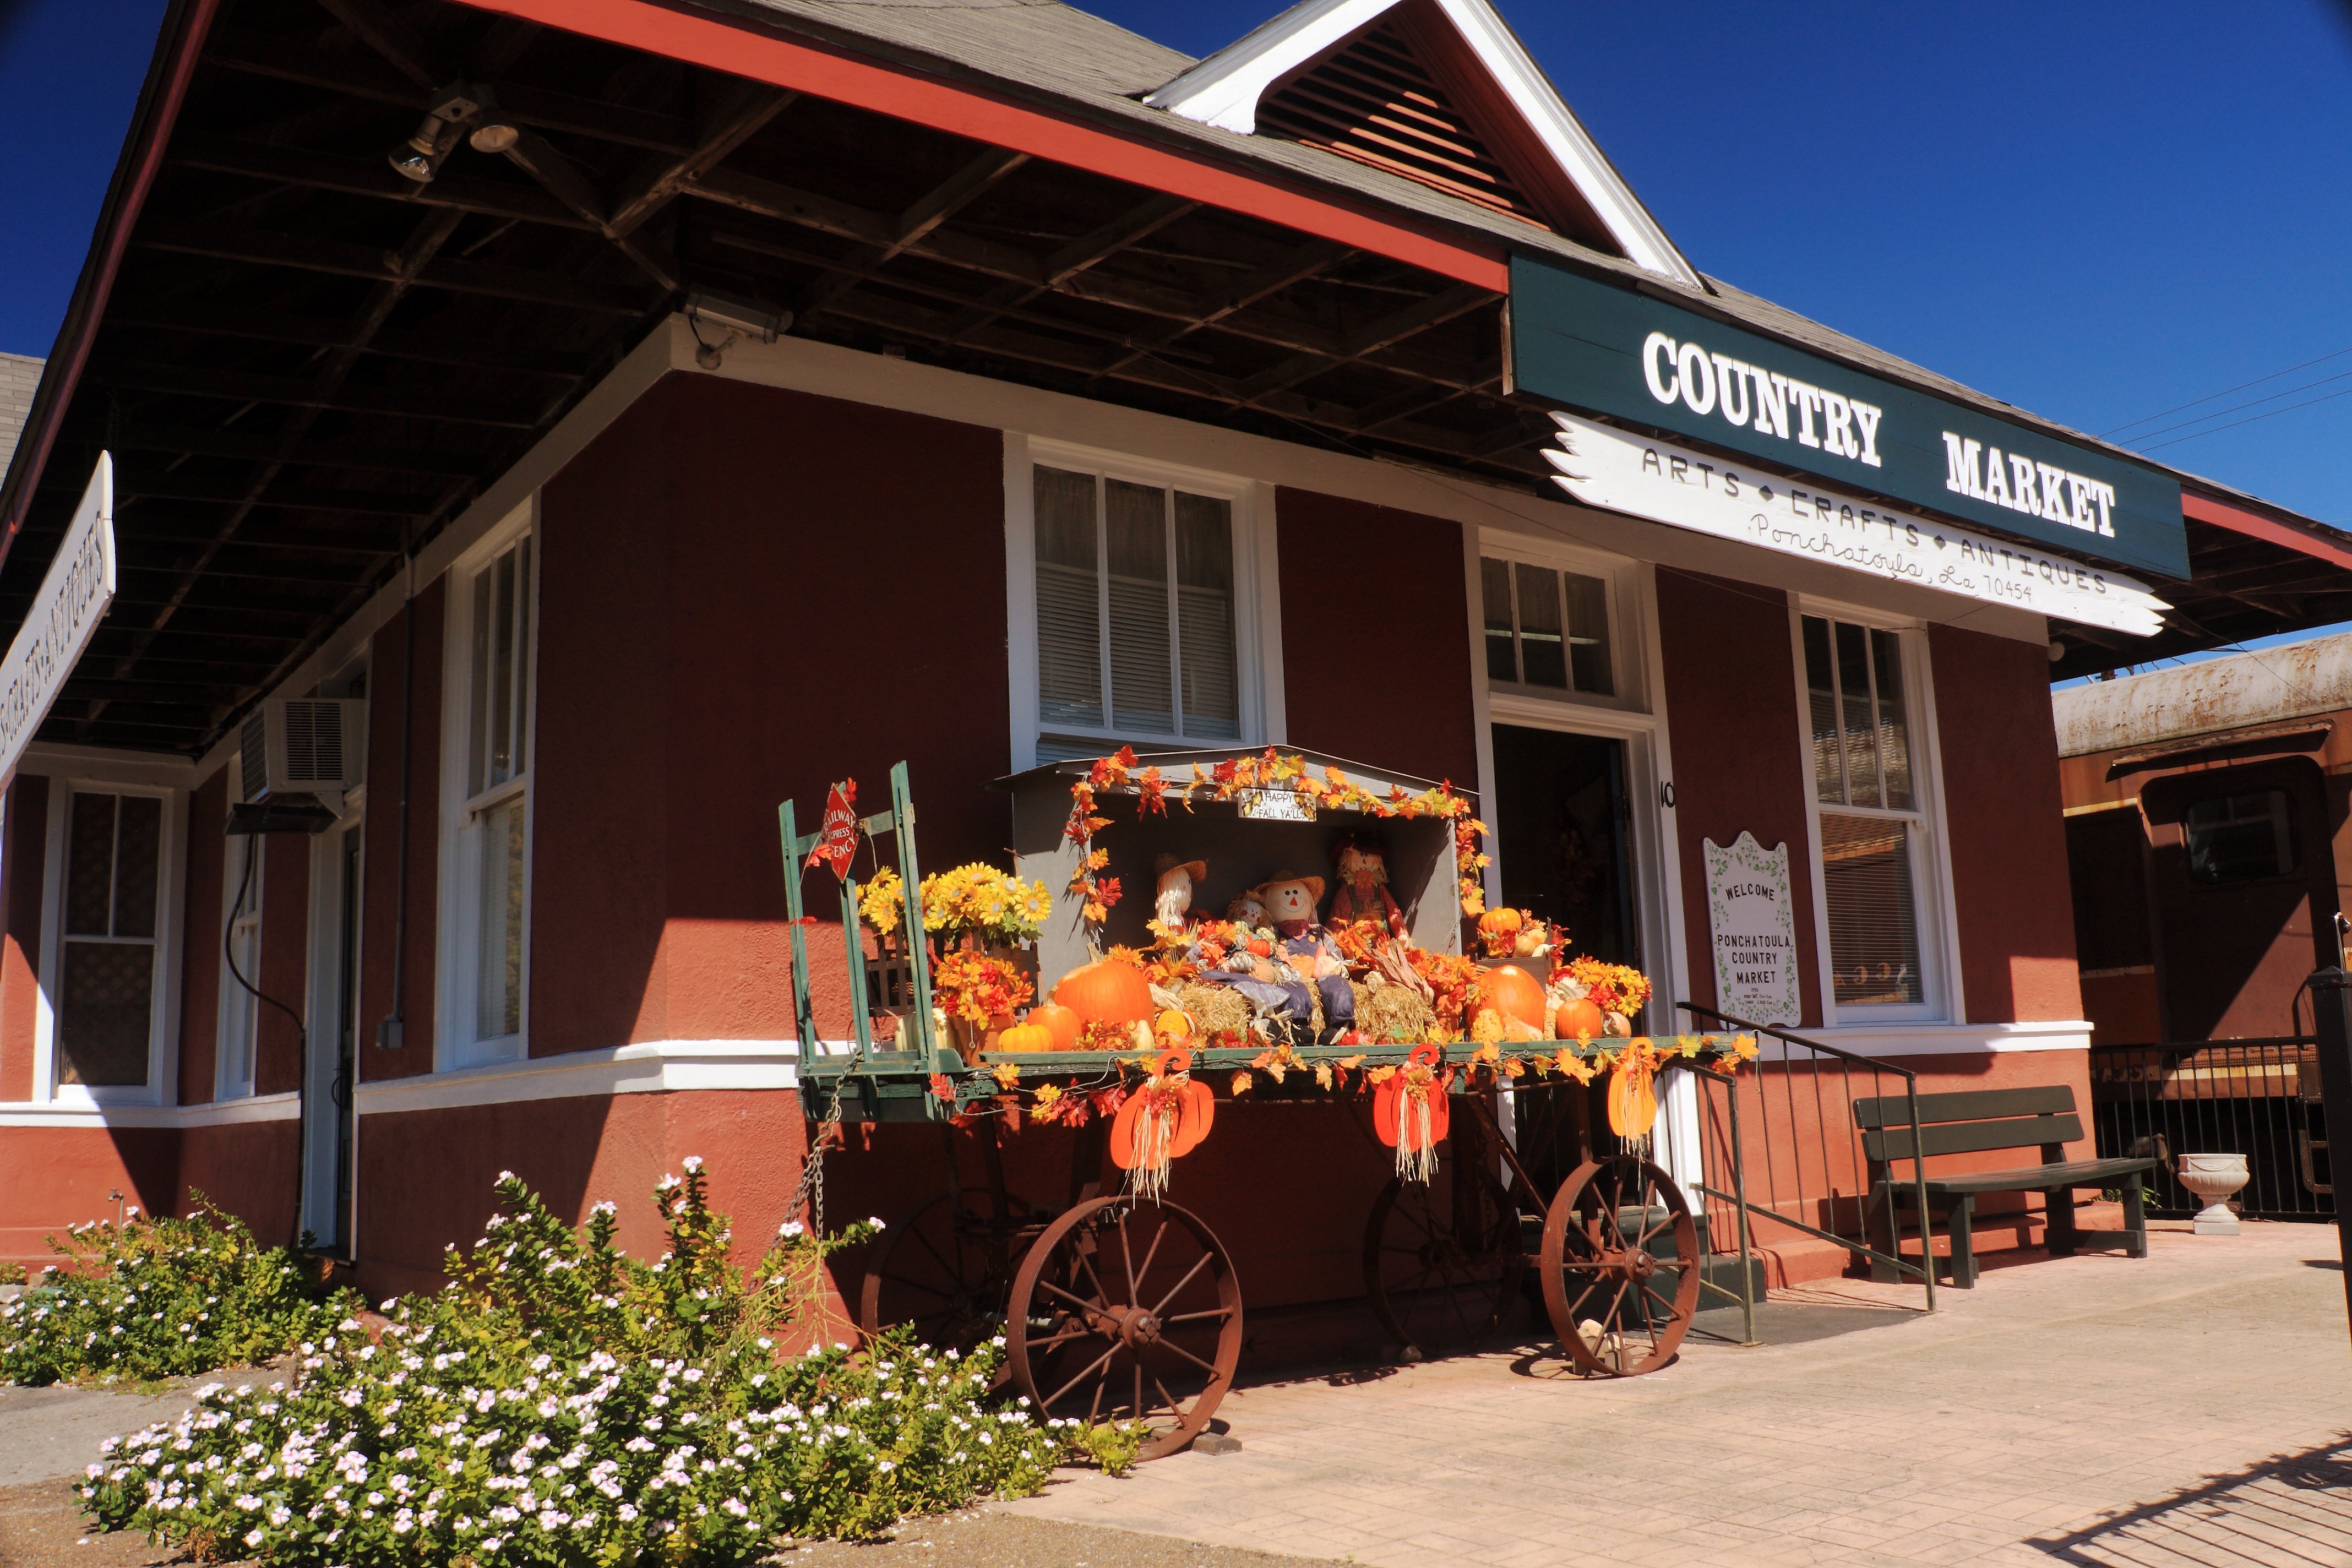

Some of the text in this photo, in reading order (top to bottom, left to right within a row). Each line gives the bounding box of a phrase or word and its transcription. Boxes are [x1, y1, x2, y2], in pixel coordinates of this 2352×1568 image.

[1643, 331, 2115, 538] COUNTRY MARKET
[1642, 448, 2107, 594] ARTS CRAFTS ANTIQUES
[1939, 565, 1975, 589] La
[1983, 575, 2032, 603] 70454
[8, 508, 103, 742] CRAFTS ANTIQUES
[1265, 793, 1294, 803] HAPPY
[1660, 781, 1676, 808] 10
[1259, 809, 1277, 819] FALL
[1725, 883, 1774, 901] WELCOME
[1717, 934, 1790, 948] PONCHATOULA
[1732, 952, 1777, 965] COUNTRY
[1736, 971, 1776, 984] MARKET
